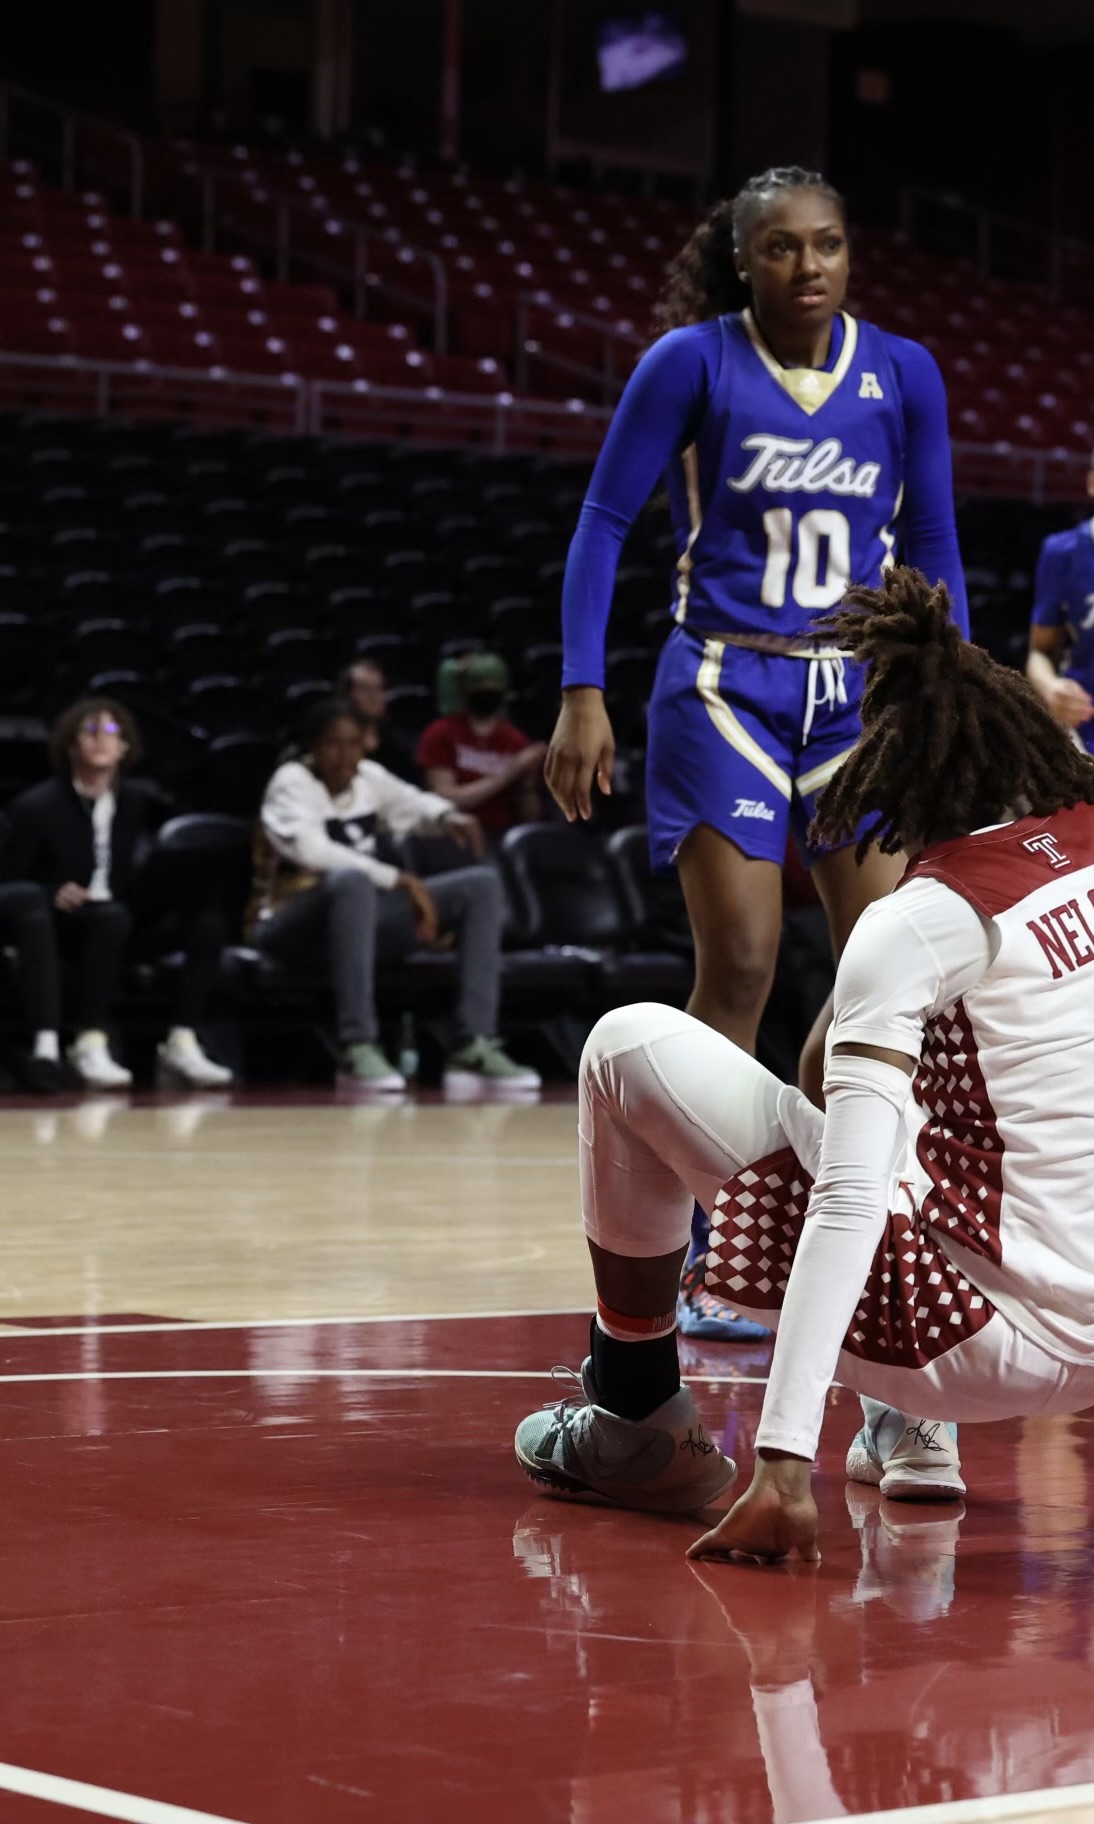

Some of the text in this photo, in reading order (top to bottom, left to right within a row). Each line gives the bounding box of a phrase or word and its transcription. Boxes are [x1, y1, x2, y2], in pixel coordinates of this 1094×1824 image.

[726, 433, 882, 499] Tulsa
[760, 507, 850, 609] 10
[730, 798, 776, 823] Tulsa
[1022, 832, 1070, 869] T
